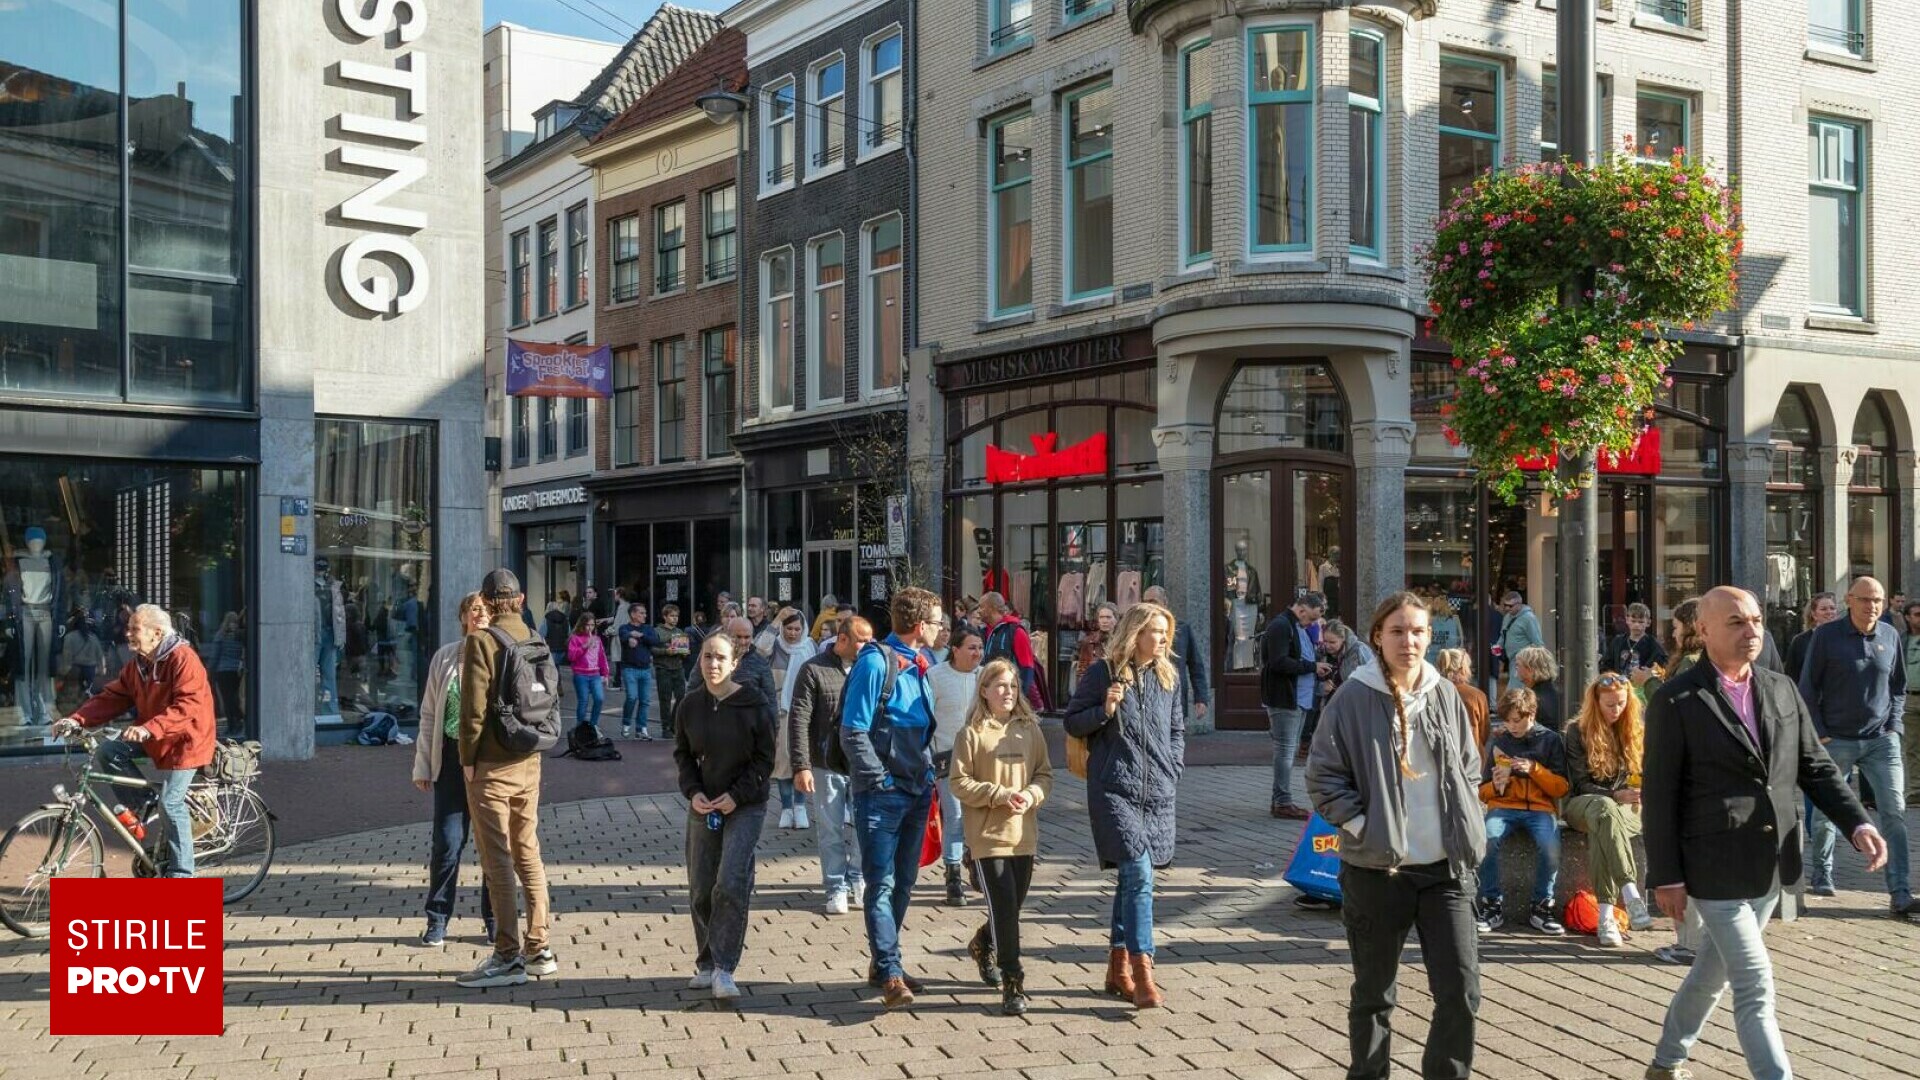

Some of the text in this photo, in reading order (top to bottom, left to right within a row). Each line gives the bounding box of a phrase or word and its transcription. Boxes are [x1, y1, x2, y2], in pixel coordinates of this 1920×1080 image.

[339, 0, 430, 314] STING
[963, 334, 1123, 386] MUSISKWARTIER
[503, 487, 587, 512] KINDER TIENERMODE
[769, 548, 801, 563] TOMMY
[859, 544, 890, 559] TOMM
[656, 553, 687, 566] TOMMY
[781, 562, 801, 572] JEANS
[670, 566, 687, 575] JEANS
